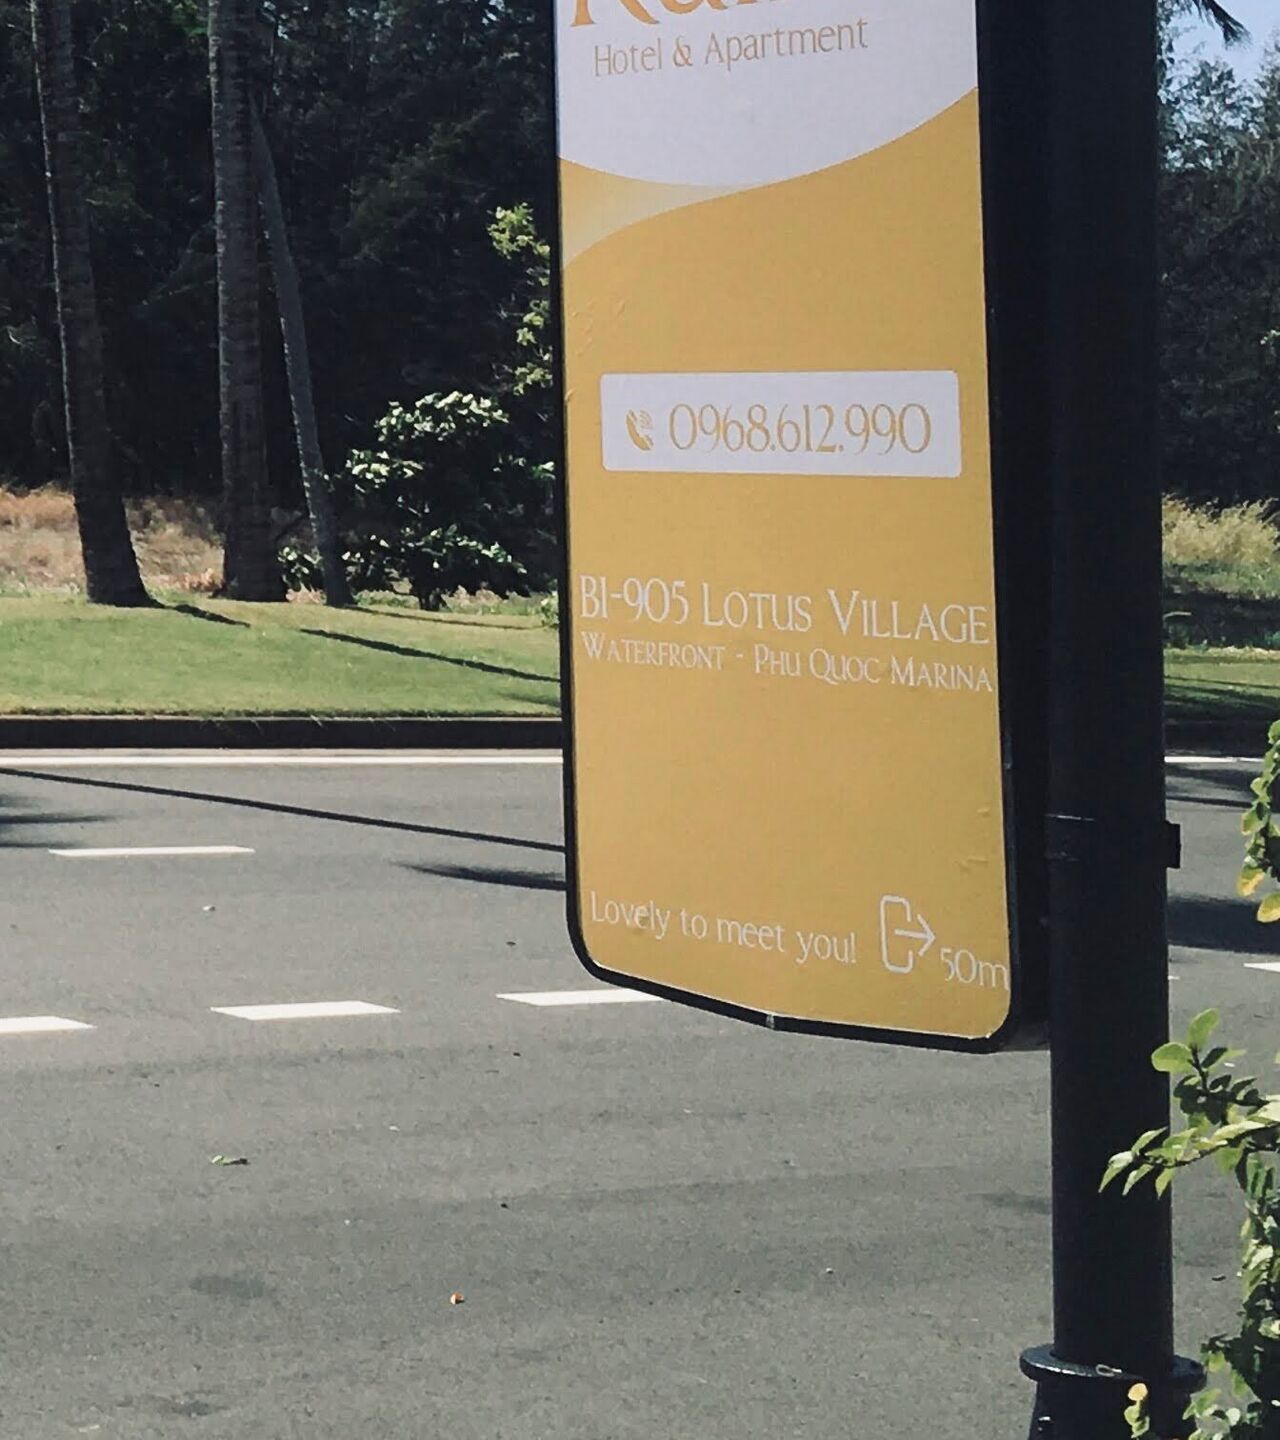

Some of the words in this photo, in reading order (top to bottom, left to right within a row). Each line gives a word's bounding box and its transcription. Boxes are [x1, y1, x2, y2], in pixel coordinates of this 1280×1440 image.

[594, 37, 663, 78] Hotel
[672, 34, 694, 68] &
[704, 17, 870, 72] Apartment
[669, 402, 932, 456] 0968.612.990
[590, 890, 671, 941] Lovely
[679, 908, 709, 940] to
[716, 917, 786, 954] meet
[795, 929, 858, 965] you!
[940, 946, 1012, 992] 50m
